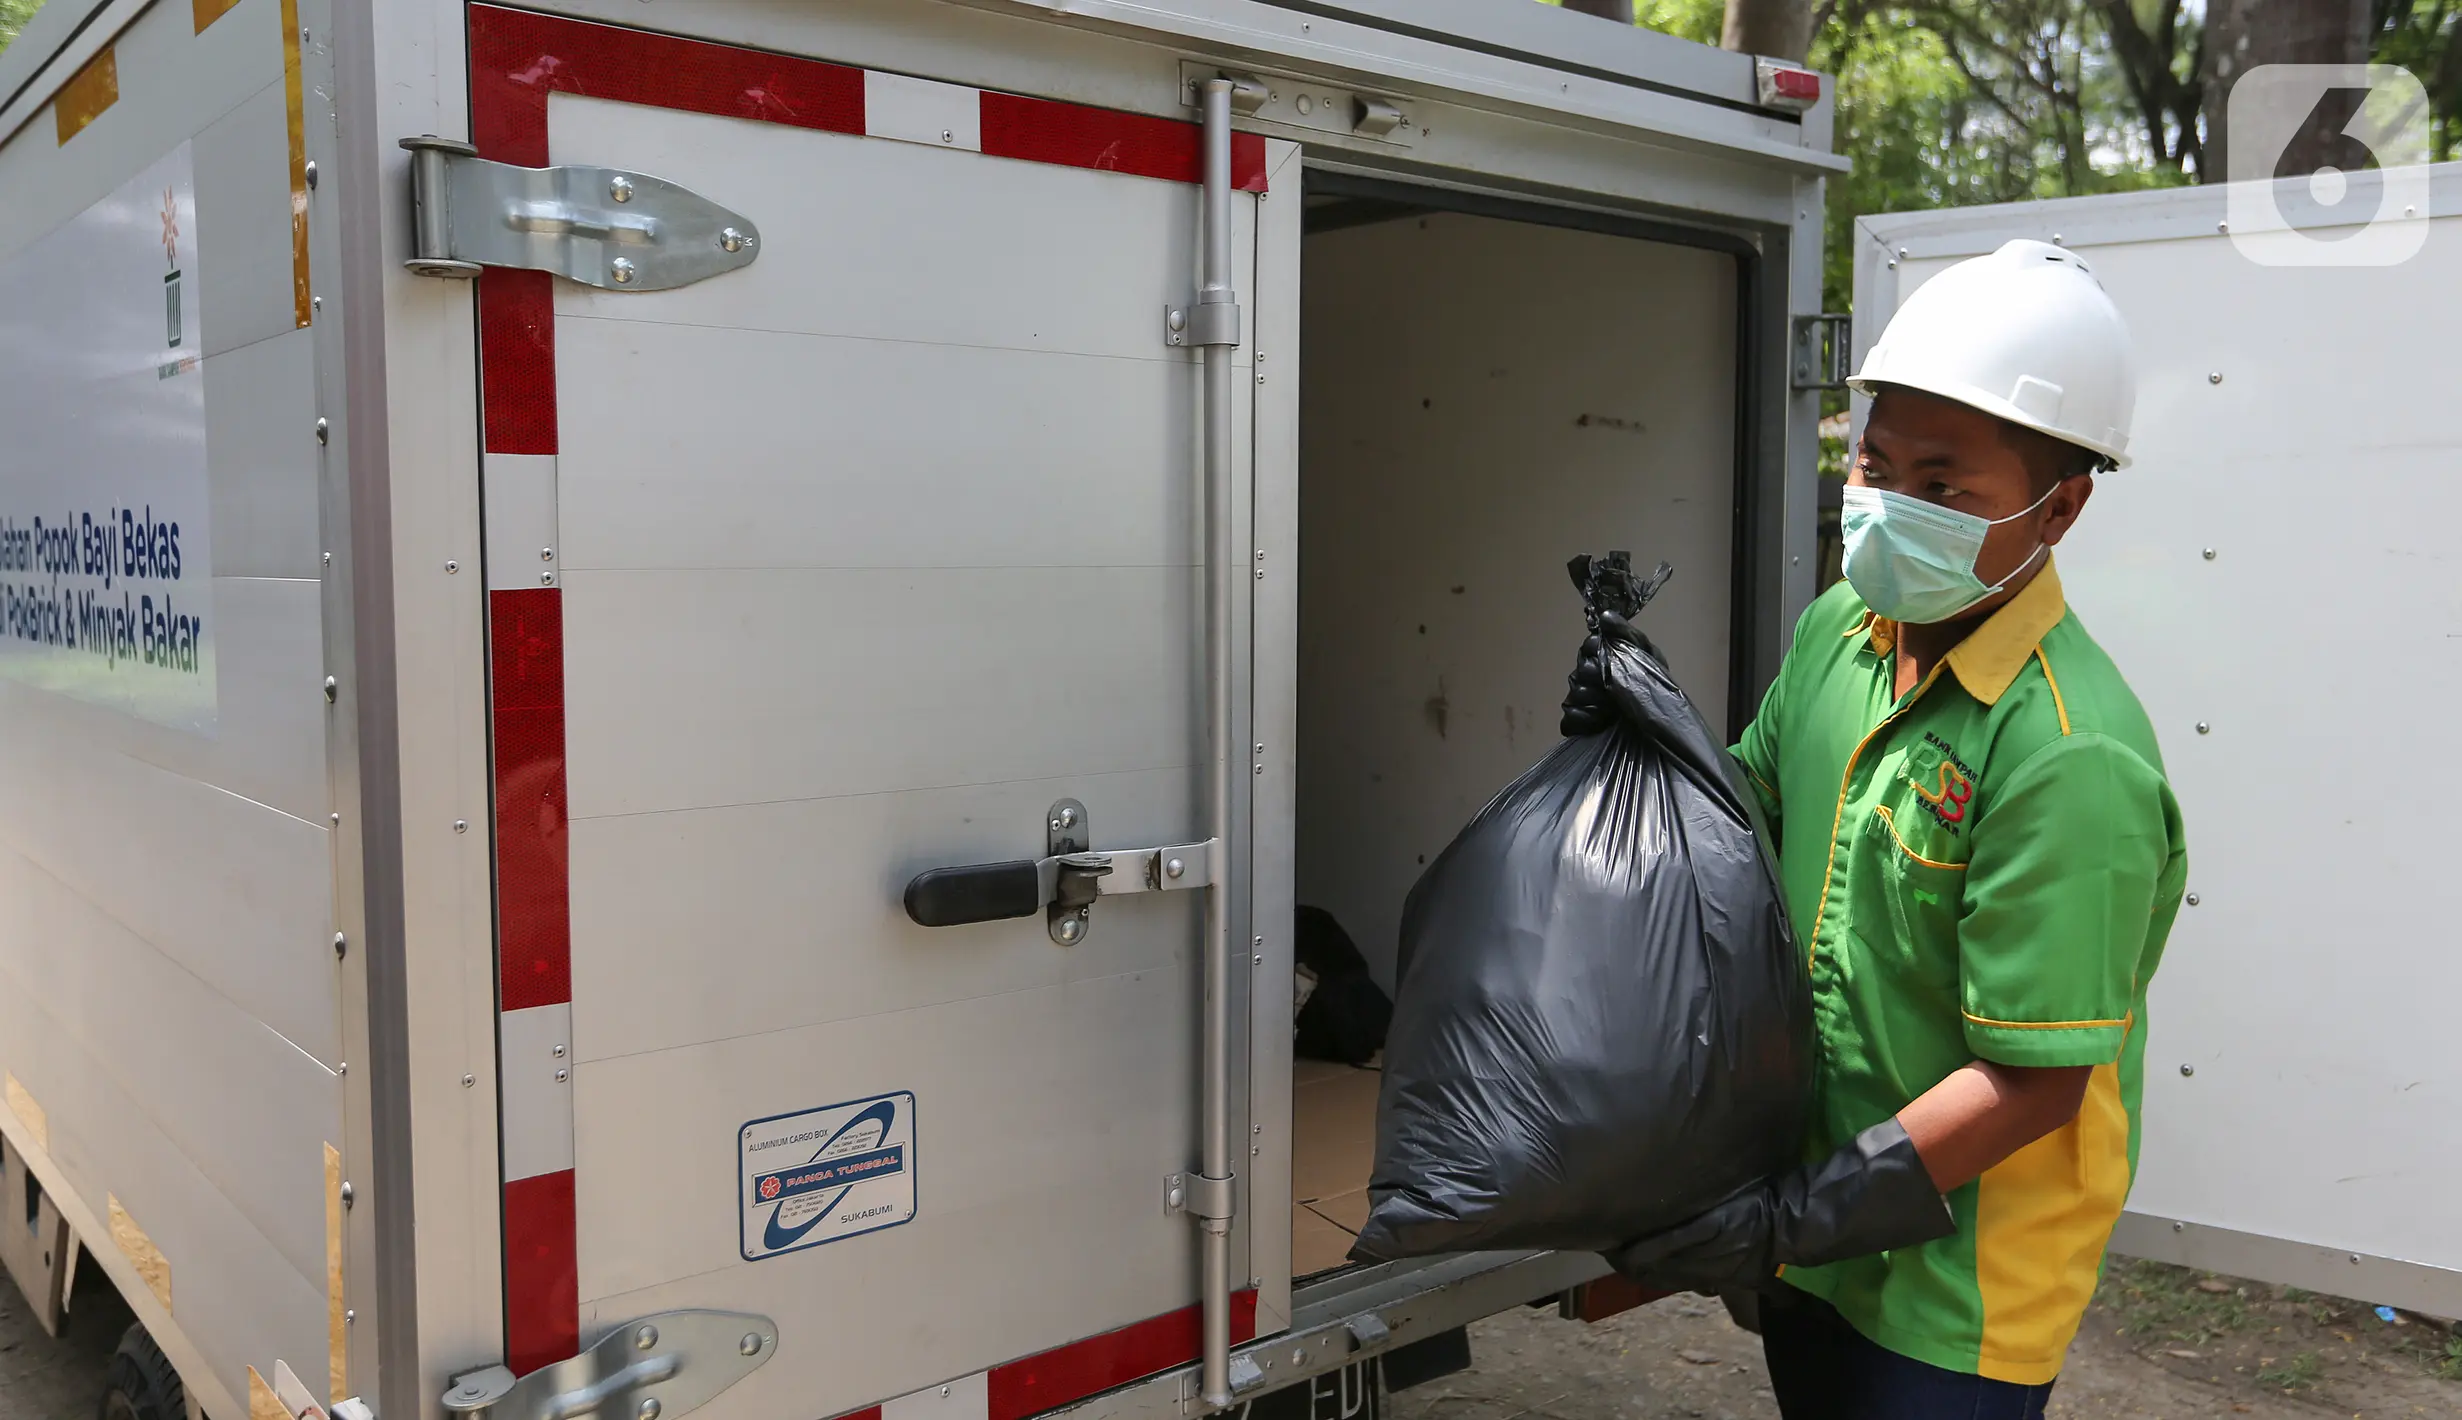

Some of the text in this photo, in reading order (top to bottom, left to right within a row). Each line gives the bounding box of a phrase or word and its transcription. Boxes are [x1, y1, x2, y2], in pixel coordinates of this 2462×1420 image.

[34, 510, 80, 586] Popok
[82, 507, 119, 590] Bayi
[122, 504, 181, 581] Bekas
[7, 583, 63, 646] PokBrick
[66, 588, 77, 649] &
[78, 588, 138, 672] Minyak
[142, 594, 201, 675] Bakar
[748, 1128, 829, 1153] ALUMINIUM CARGO BOX
[786, 1155, 899, 1188] PANCA TUNGGAL
[840, 1204, 893, 1224] SUKABUMI
